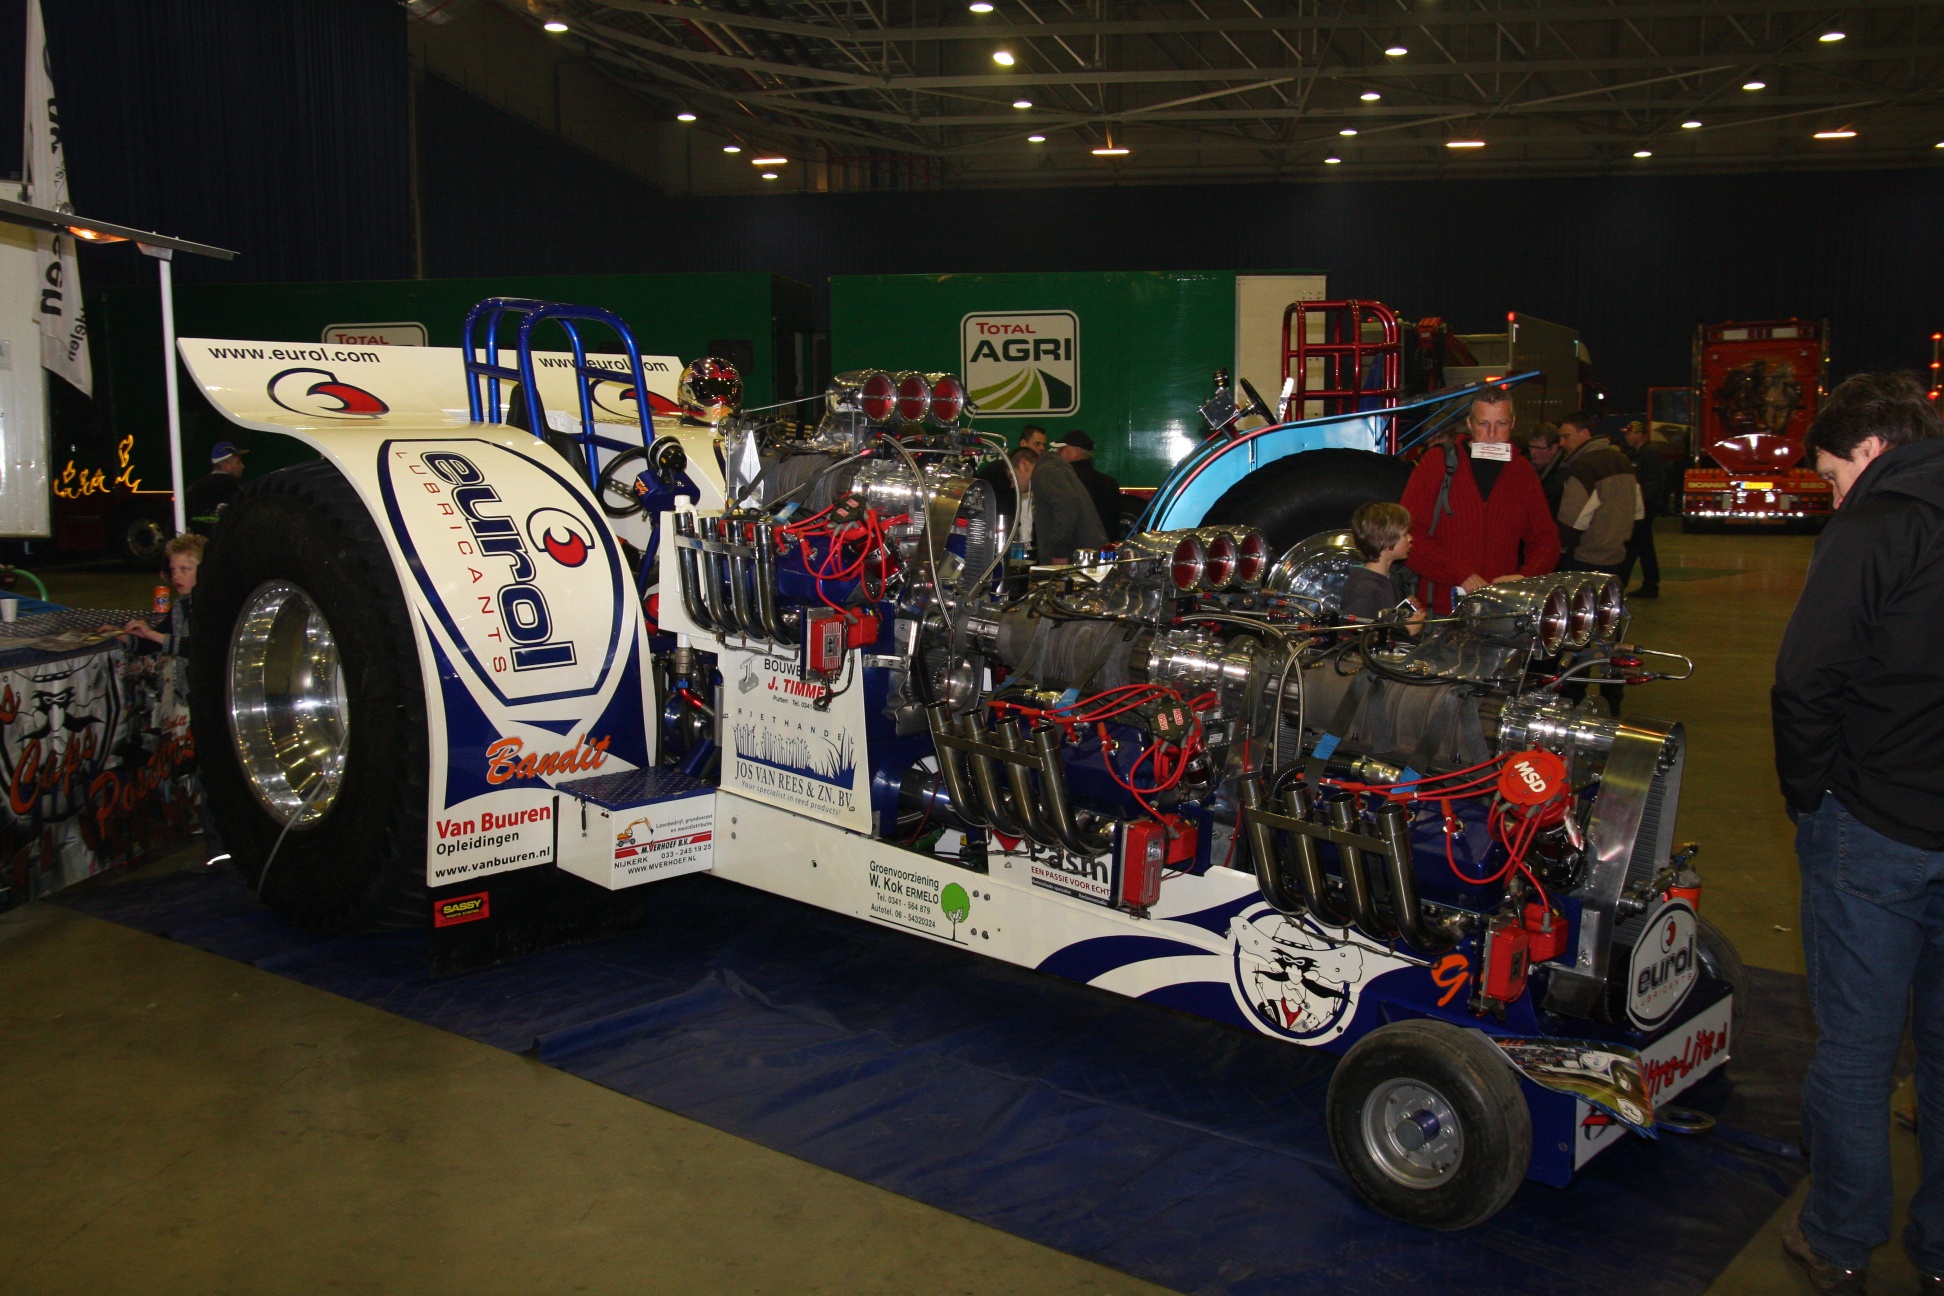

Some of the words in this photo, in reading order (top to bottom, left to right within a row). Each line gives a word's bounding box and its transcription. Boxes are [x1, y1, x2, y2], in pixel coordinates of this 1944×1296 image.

[975, 322, 1036, 335] TOTAL
[208, 347, 381, 363] www.eurol.com
[969, 338, 1072, 362] AGRI
[538, 357, 669, 372] wwweurolom
[395, 450, 508, 673] LUBRICANTS
[420, 451, 578, 673] eurol
[768, 676, 779, 691] J.
[783, 679, 835, 703] TIMME
[738, 708, 855, 744] RIETHANDEL
[485, 733, 612, 785] Bandit
[735, 760, 753, 780] JOS
[756, 766, 775, 786] VAN
[778, 772, 803, 795] REES
[806, 781, 815, 798] &
[817, 784, 835, 805] ZN.
[1514, 761, 1547, 793] MSD
[741, 780, 756, 790] Your
[756, 784, 786, 799] specialist
[787, 792, 794, 801] in
[795, 795, 809, 806] reed
[436, 818, 476, 840] Van
[481, 806, 551, 833] Buuren
[436, 832, 520, 856] Opleidingen
[661, 851, 674, 859] 033
[679, 847, 692, 856] 245
[694, 845, 702, 853] 19
[703, 843, 712, 851] 25
[435, 846, 551, 878] www.vanbuuren.nl
[614, 856, 648, 869] NIJKERK
[627, 855, 697, 874] WWW.MVERHOEF.NL
[869, 860, 939, 891] Groenvoorziening
[869, 873, 881, 888] W.
[884, 877, 903, 895] Kok
[905, 886, 939, 904] ERMELO
[1031, 866, 1045, 876] EEN
[1045, 871, 1069, 884] PASSIE
[1070, 879, 1090, 891] VOOR
[1091, 885, 1111, 896] ECHT
[443, 899, 482, 914] SASSY
[871, 903, 893, 916] Autotel.
[894, 909, 902, 919] 06
[877, 892, 886, 902] Tel.
[888, 896, 902, 906] 0341
[907, 901, 918, 911] 564
[919, 904, 931, 915] 879
[1637, 933, 1694, 997] eurol
